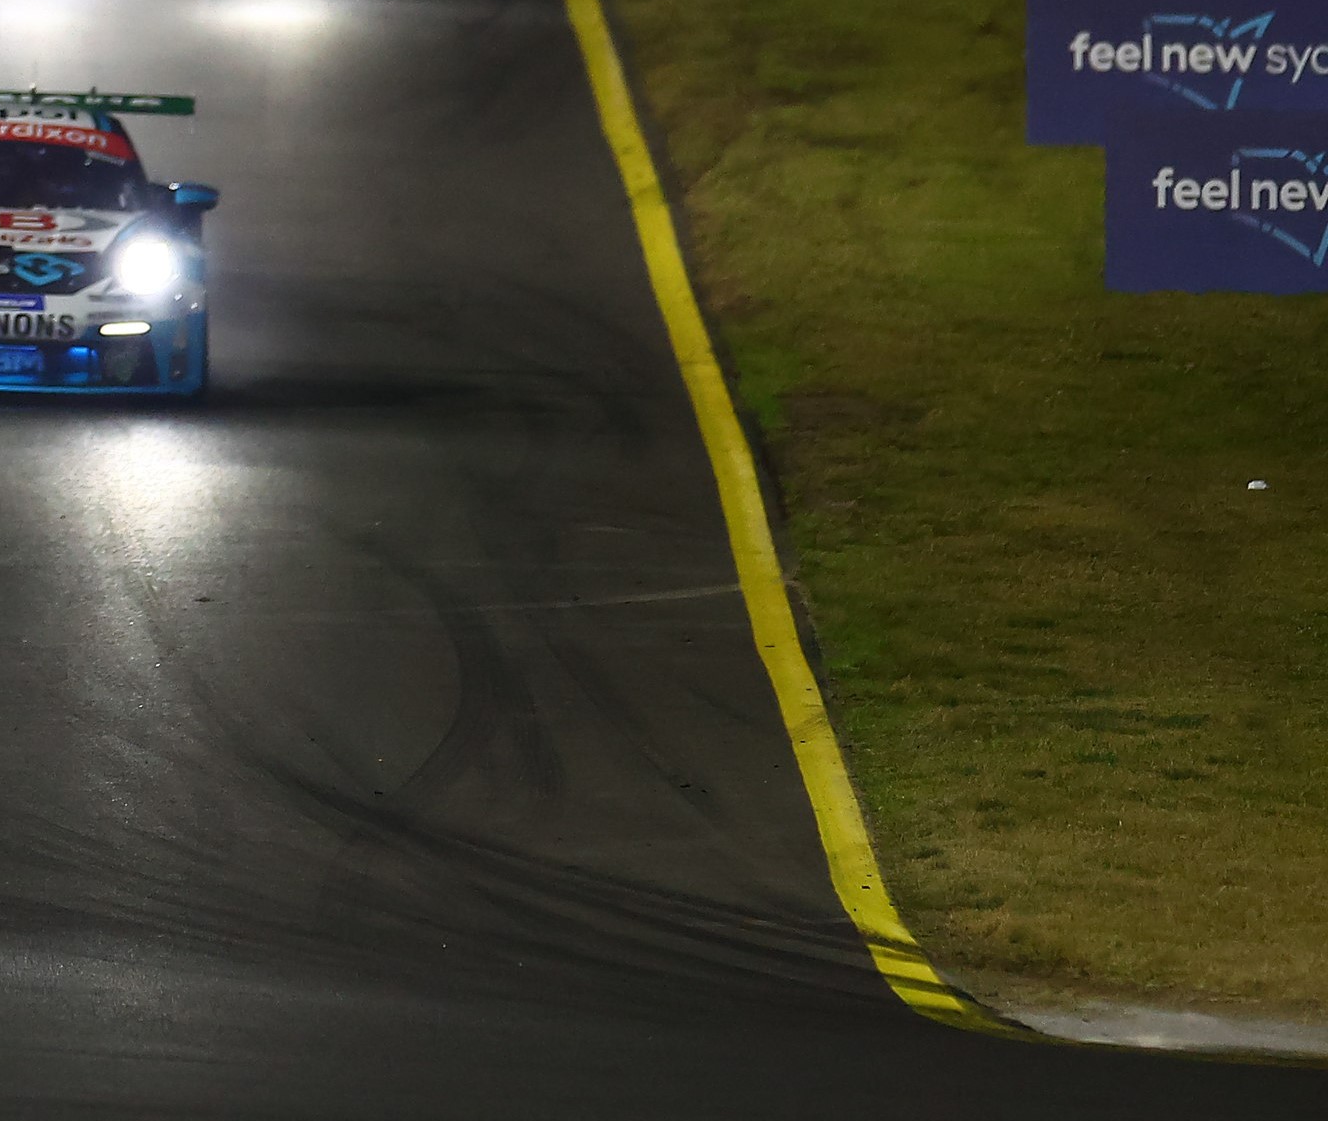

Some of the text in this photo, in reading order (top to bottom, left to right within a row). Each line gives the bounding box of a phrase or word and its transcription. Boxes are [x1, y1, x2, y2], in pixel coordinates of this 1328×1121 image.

[1070, 31, 1153, 73] feel
[1162, 43, 1258, 74] new
[1152, 168, 1241, 211] feel
